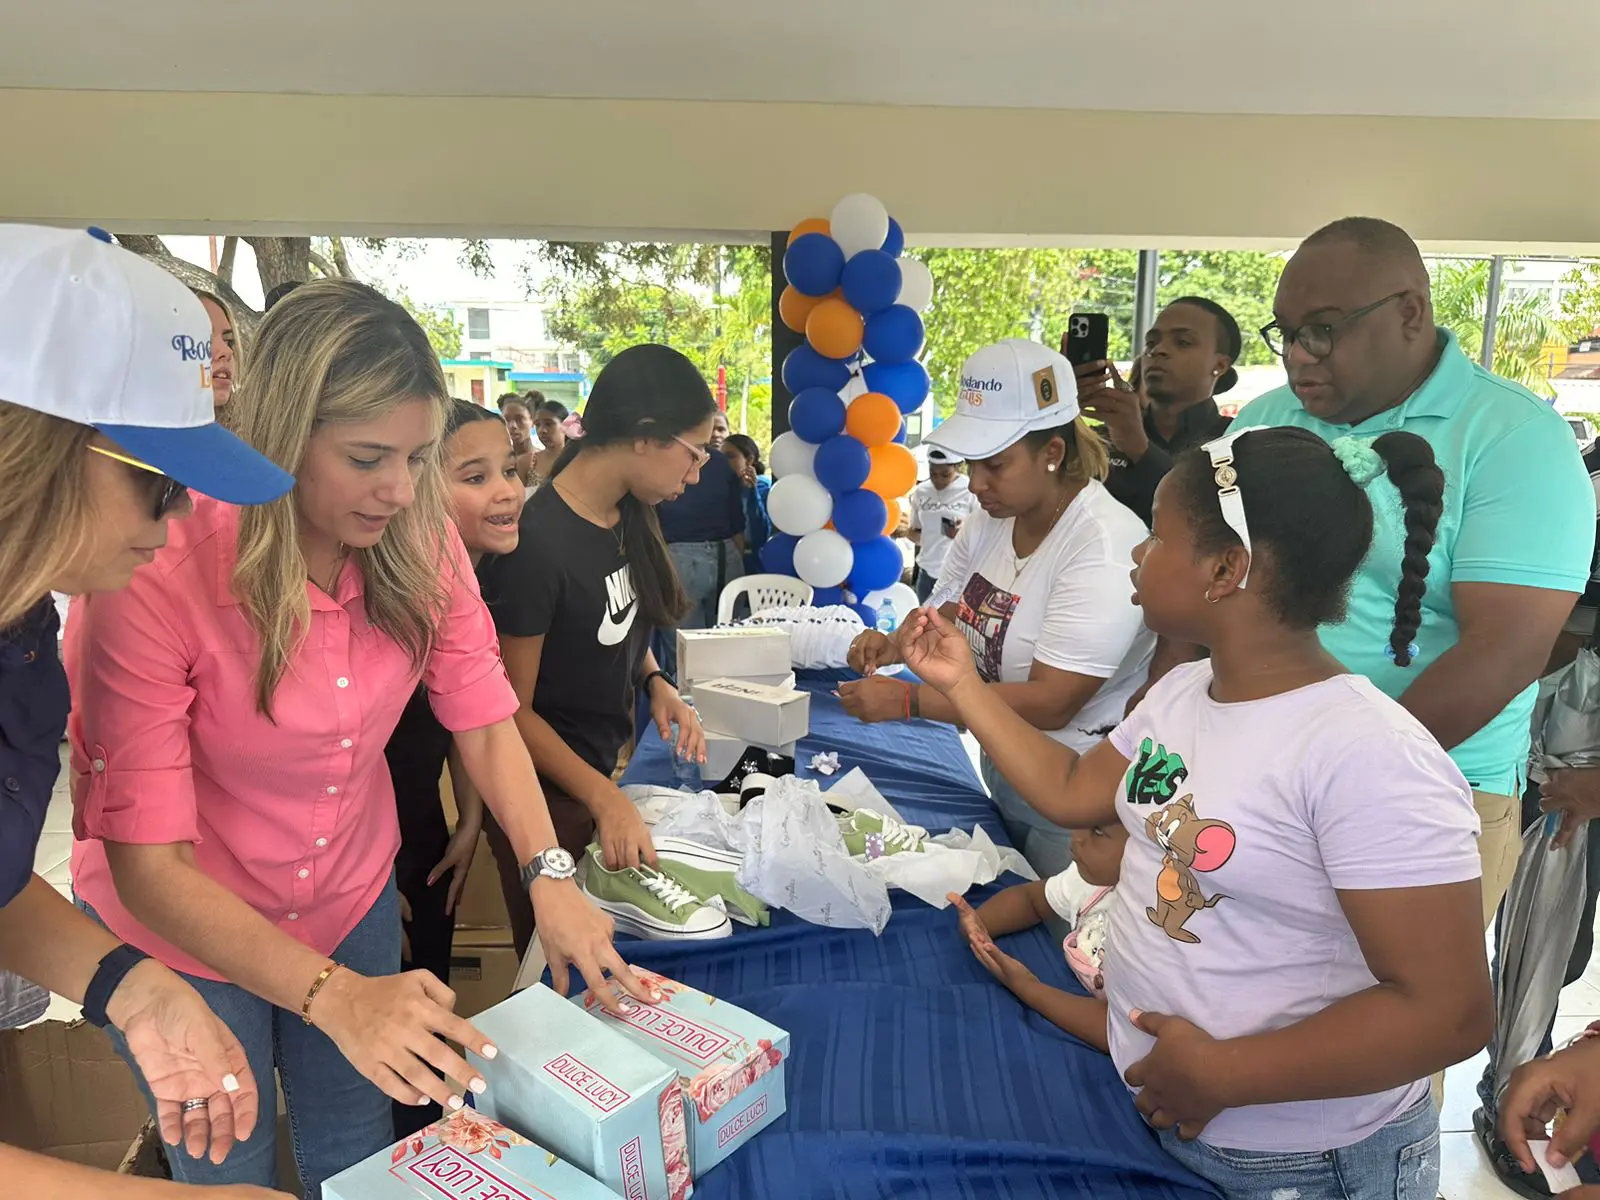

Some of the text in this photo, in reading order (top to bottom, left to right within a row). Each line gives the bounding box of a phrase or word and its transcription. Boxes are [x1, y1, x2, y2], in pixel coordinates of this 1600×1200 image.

[1126, 737, 1188, 804] YES
[626, 1001, 719, 1053] DULCE LUC
[551, 1058, 622, 1106] DULCE LUCY
[720, 1099, 765, 1143] DULCE LUCY
[421, 1155, 485, 1194] LUCY
[623, 1142, 641, 1184] DULCE
